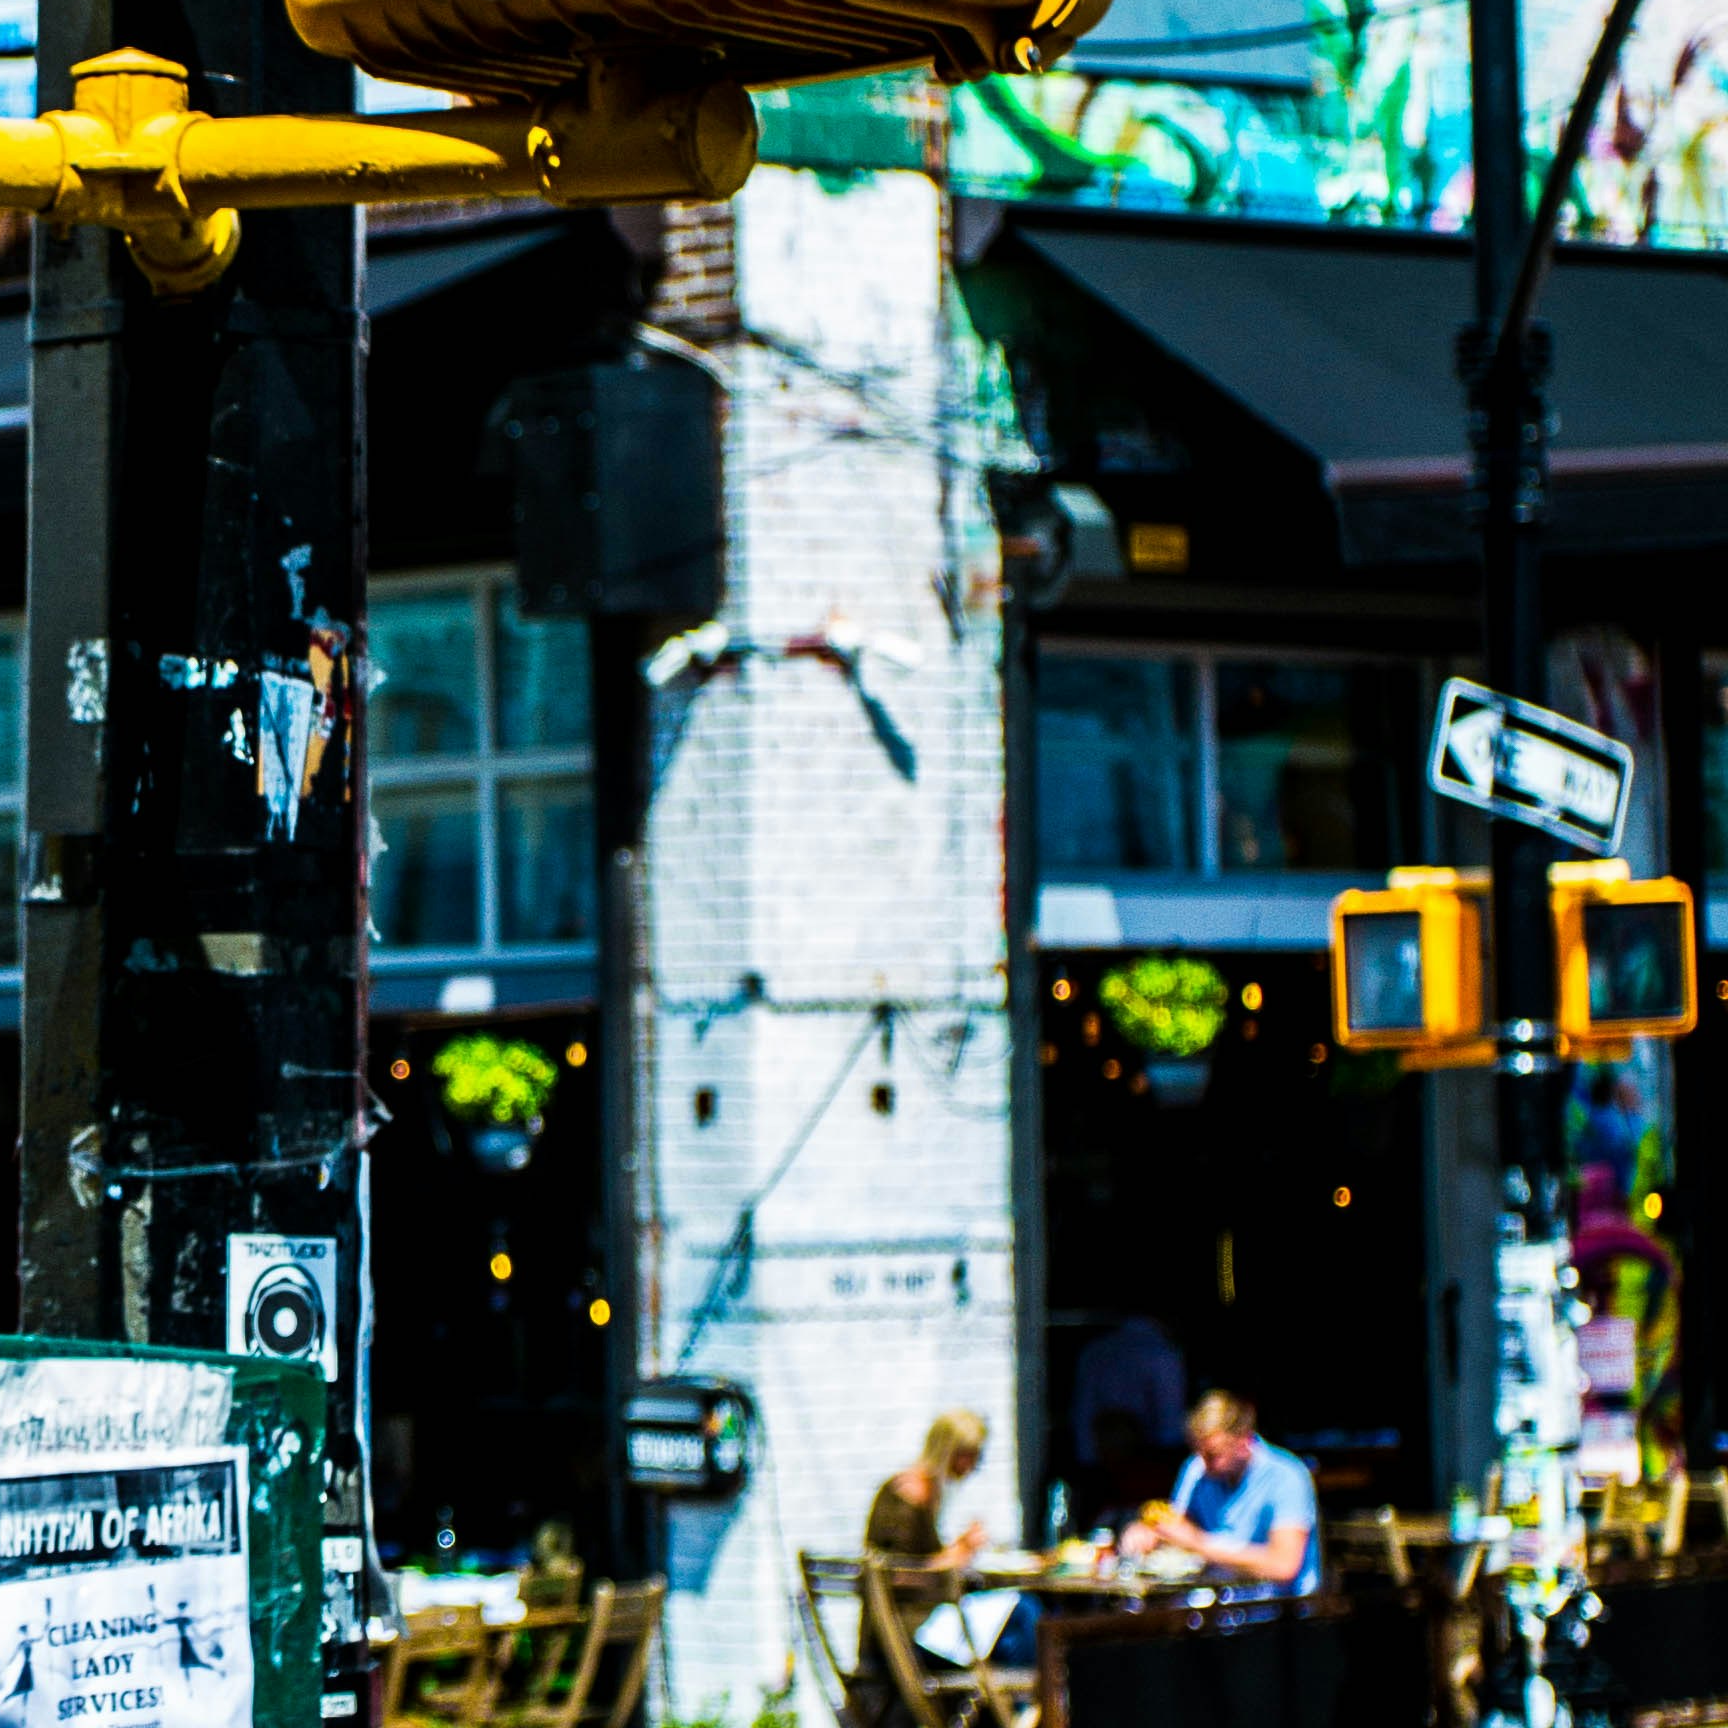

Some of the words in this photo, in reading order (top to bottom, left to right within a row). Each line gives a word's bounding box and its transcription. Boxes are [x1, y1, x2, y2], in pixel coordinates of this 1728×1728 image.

[100, 1505, 140, 1549] OF
[143, 1499, 222, 1546] AFRIKA
[47, 1613, 158, 1647] CLEANING
[71, 1652, 134, 1681] LADY
